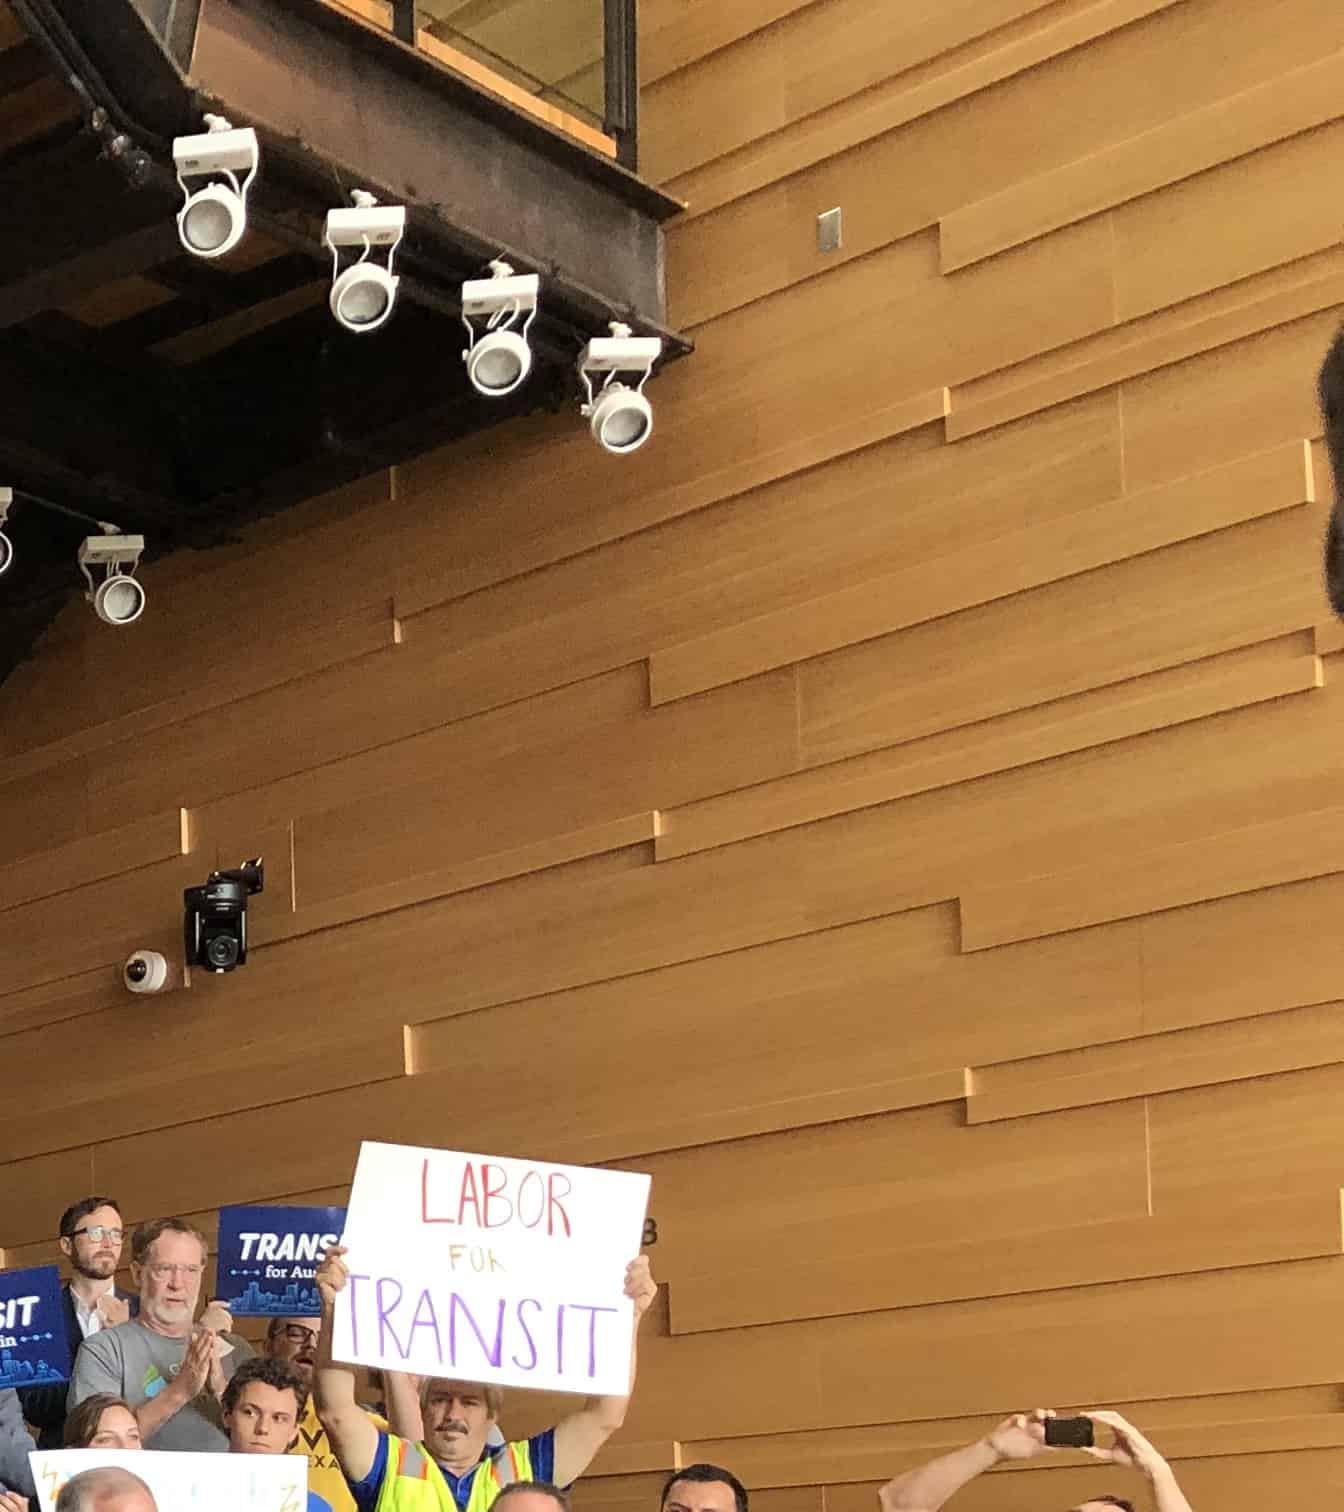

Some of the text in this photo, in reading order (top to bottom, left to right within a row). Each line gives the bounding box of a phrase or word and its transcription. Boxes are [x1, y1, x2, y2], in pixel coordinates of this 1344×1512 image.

[420, 1159, 571, 1237] LABOR
[239, 1233, 340, 1261] TRANS
[448, 1244, 507, 1273] FOR
[265, 1265, 288, 1278] for
[348, 1274, 618, 1378] TRANSIT
